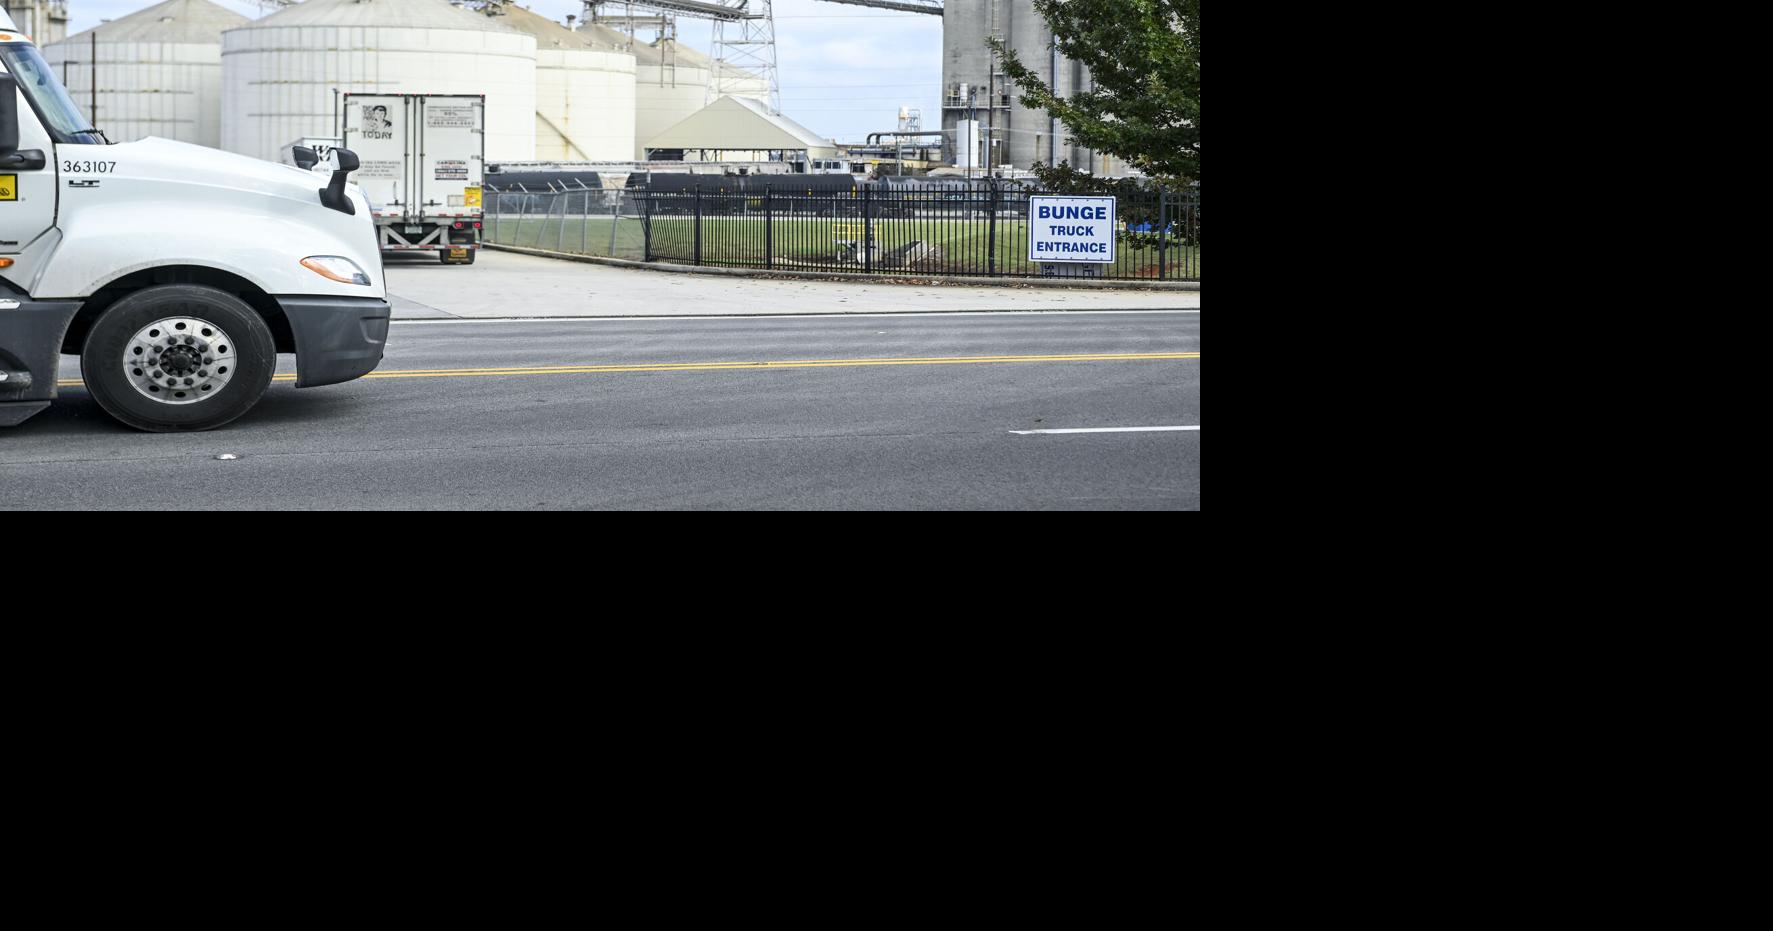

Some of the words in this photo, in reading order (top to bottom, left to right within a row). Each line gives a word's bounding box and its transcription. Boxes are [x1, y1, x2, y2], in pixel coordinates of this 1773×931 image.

[362, 131, 392, 140] TODAY
[63, 160, 117, 173] 363107
[1038, 205, 1107, 220] BUNGE
[1049, 225, 1095, 237] TRUCK
[1036, 241, 1107, 254] ENTRANCE
